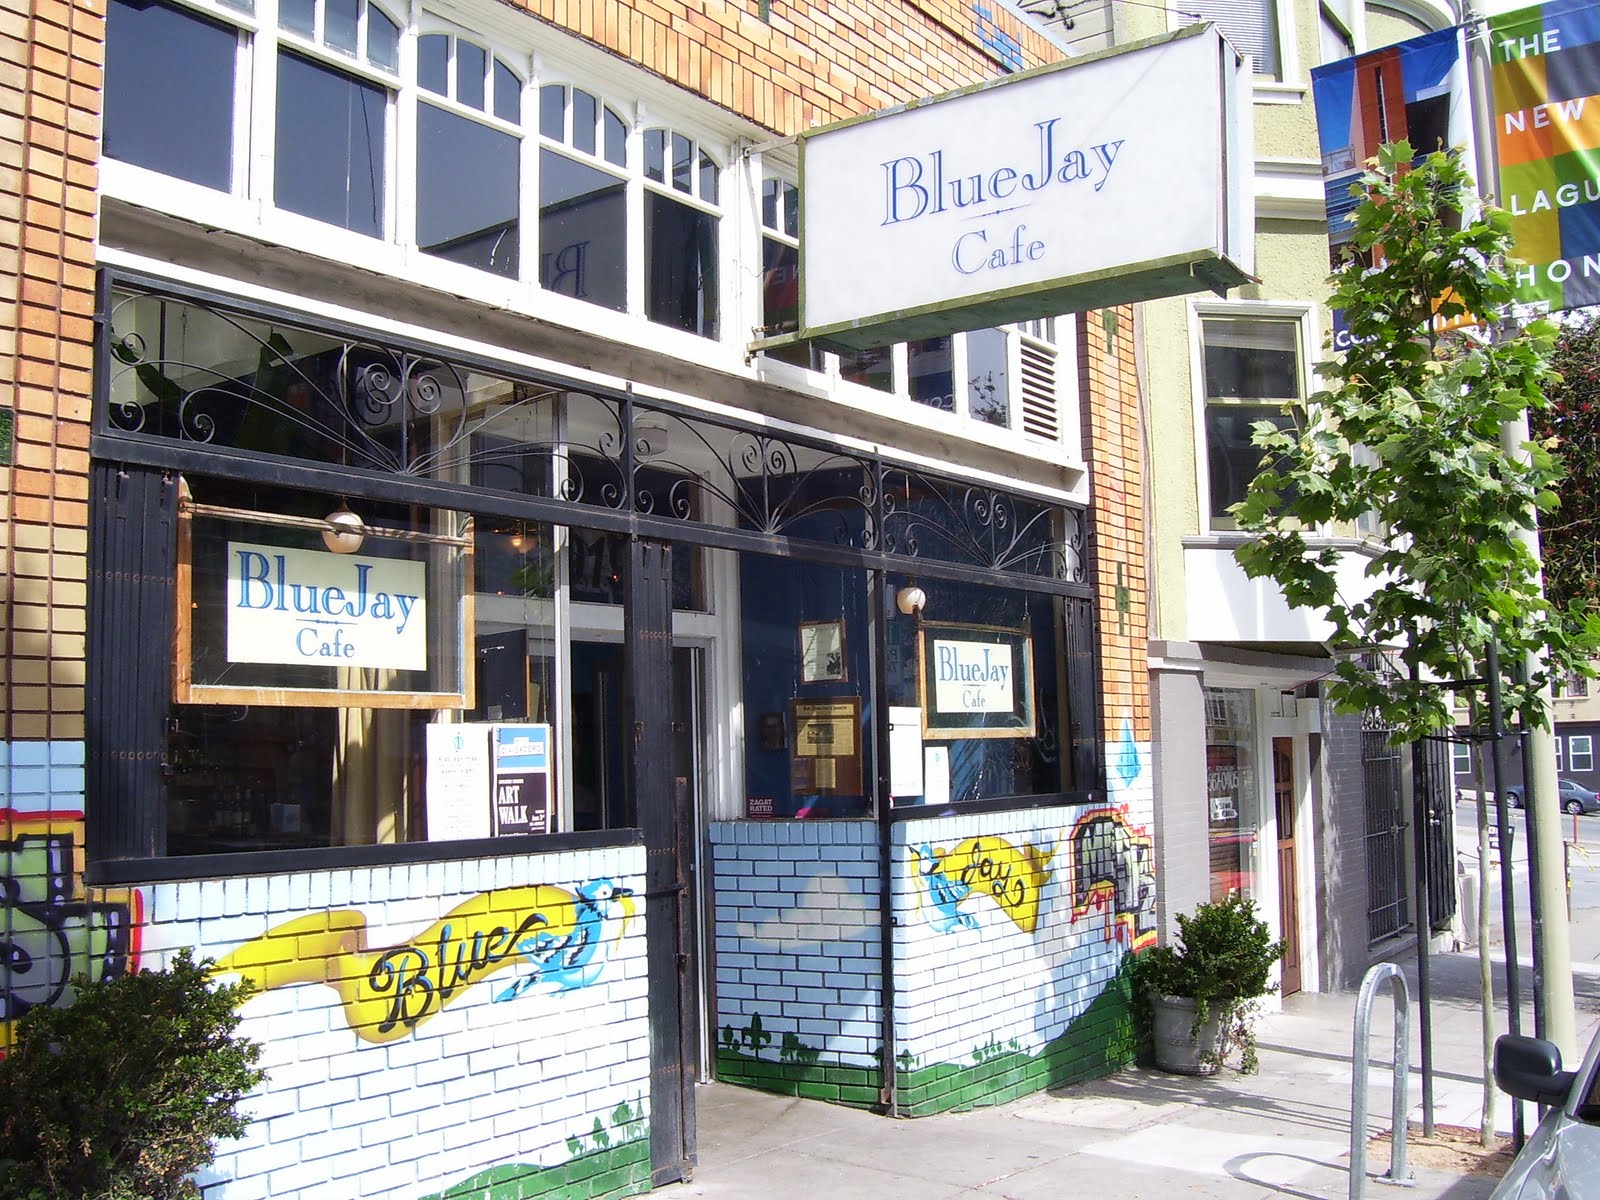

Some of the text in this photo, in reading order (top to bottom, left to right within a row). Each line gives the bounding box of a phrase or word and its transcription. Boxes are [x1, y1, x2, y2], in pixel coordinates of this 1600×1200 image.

[1499, 29, 1561, 62] THE
[1505, 97, 1585, 135] NEW
[880, 117, 1126, 226] BlueJay
[952, 224, 1046, 275] Cafe
[236, 550, 419, 634] BlueJay
[296, 627, 355, 658] Cafe
[938, 646, 1009, 690] BlueJay
[962, 690, 986, 709] Cafe
[498, 785, 520, 804] ART
[499, 805, 529, 825] WALK
[369, 913, 549, 1034] Blue
